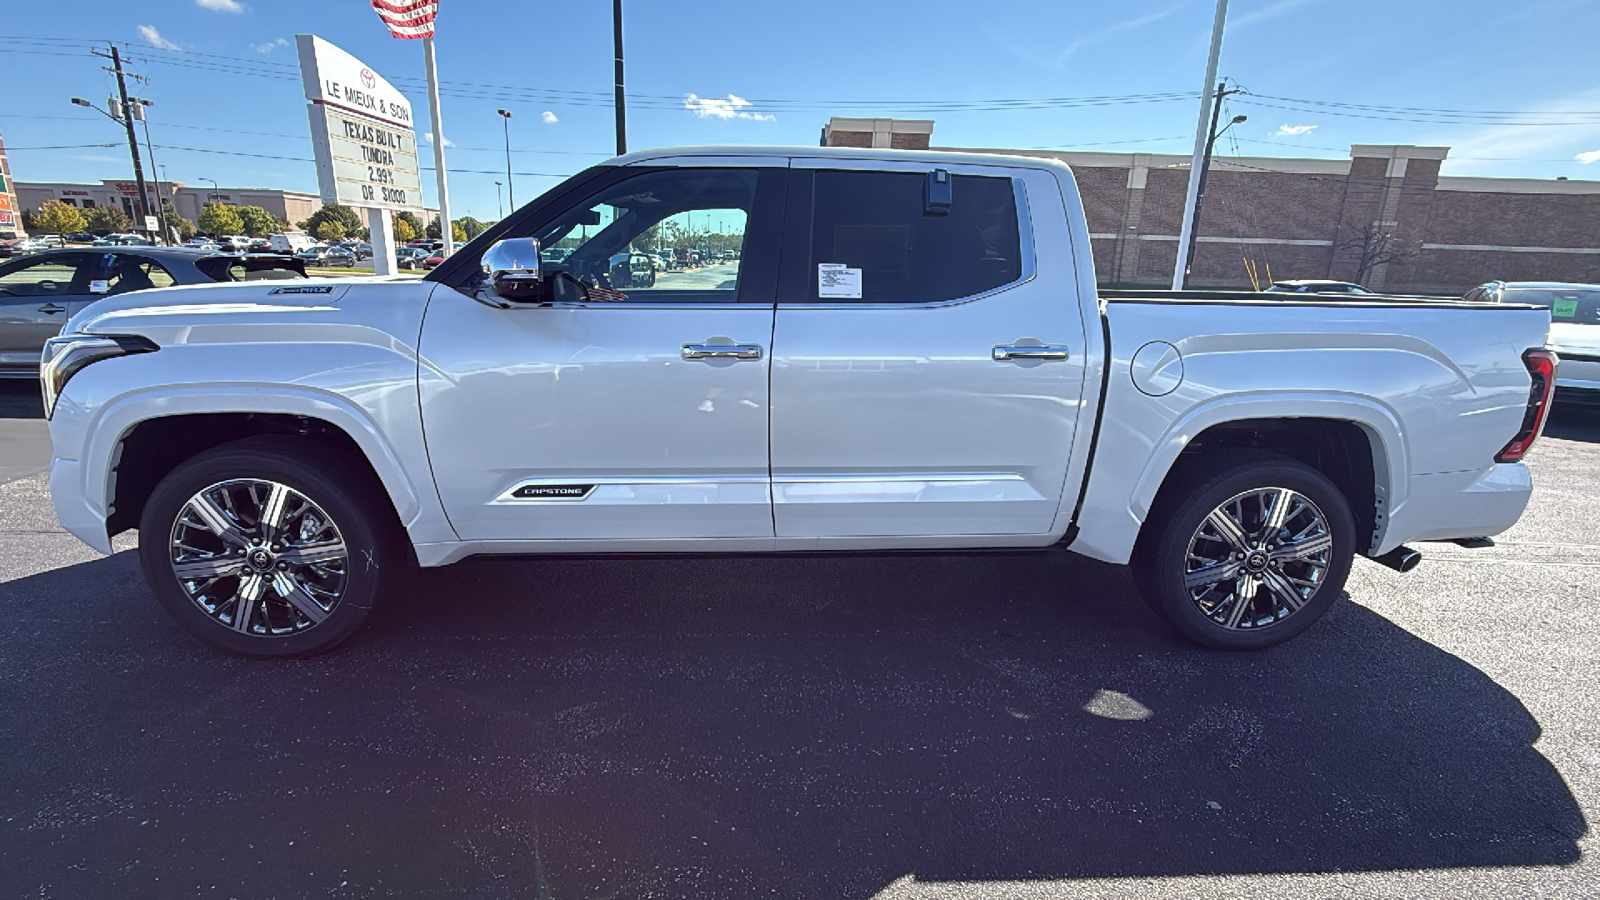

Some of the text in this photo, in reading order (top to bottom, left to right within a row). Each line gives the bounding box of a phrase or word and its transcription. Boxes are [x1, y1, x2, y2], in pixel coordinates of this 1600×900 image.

[326, 80, 409, 122] LE MIEUX & SON
[343, 120, 402, 150] TEXAS BUILT
[361, 145, 394, 166] TUNDRA
[368, 166, 394, 185] 2.99%
[361, 184, 406, 204] OR $1000
